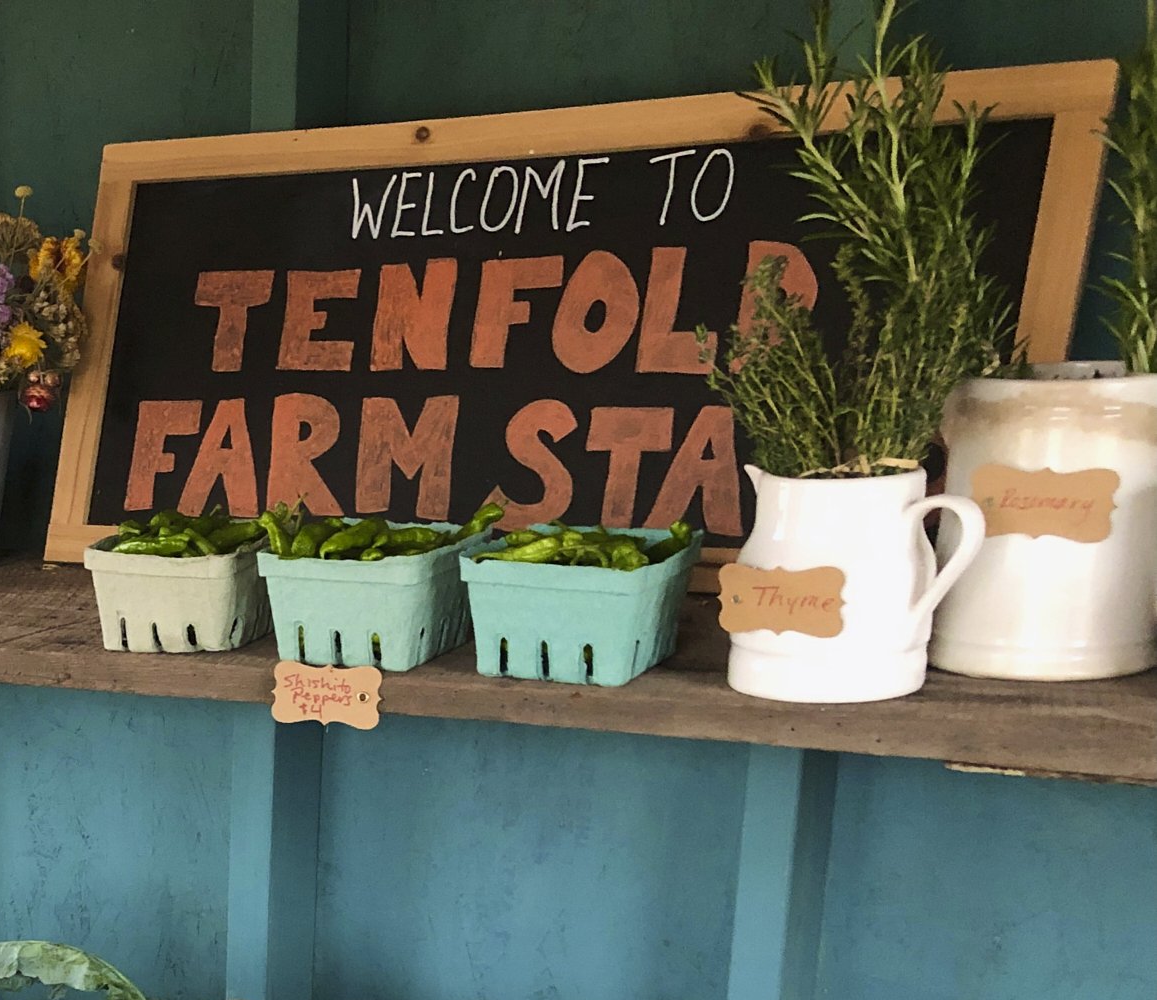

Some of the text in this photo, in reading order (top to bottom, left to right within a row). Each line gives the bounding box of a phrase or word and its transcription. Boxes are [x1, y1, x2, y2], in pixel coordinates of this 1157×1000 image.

[351, 148, 734, 240] WELCOME TO
[194, 240, 819, 375] TENFOLD
[123, 392, 460, 520] FARM
[751, 585, 835, 615] Thyme
